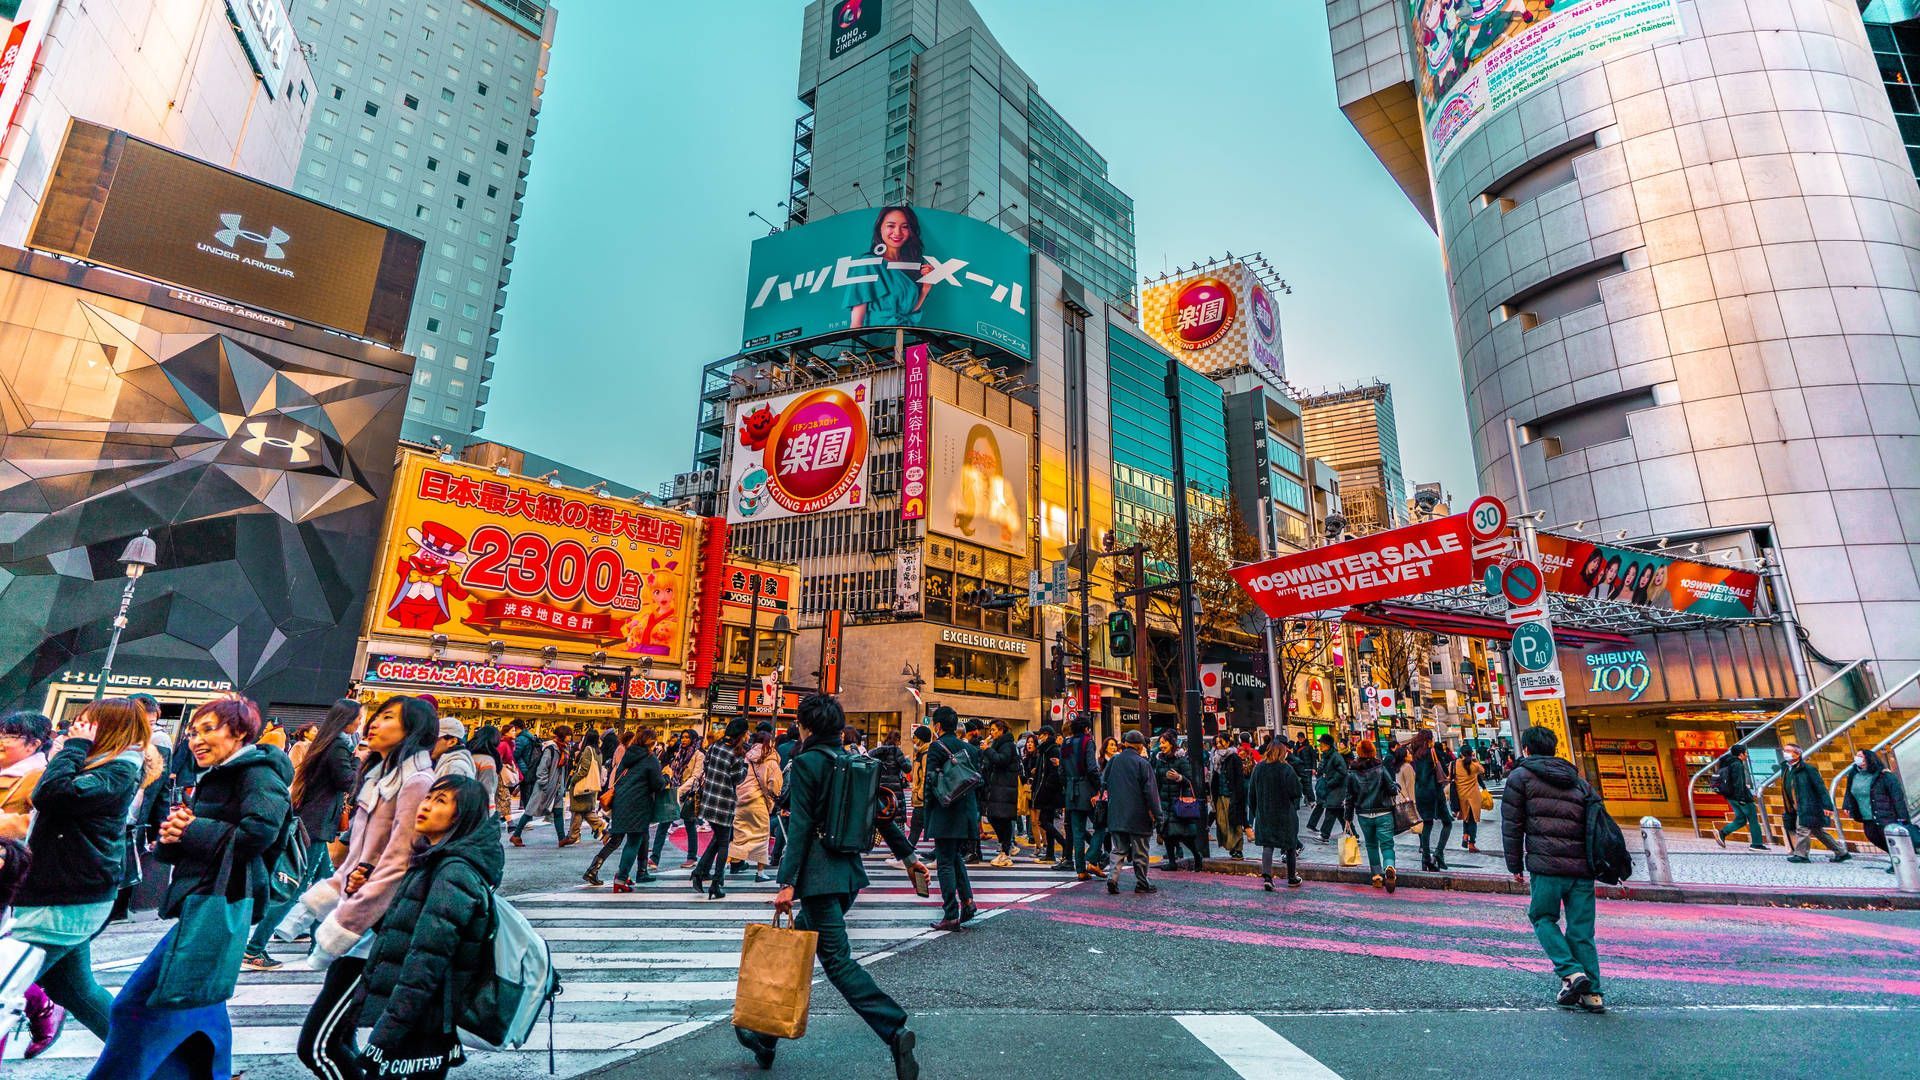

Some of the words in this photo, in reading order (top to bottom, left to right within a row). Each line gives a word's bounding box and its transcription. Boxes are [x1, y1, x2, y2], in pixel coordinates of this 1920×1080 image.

[836, 27, 859, 45] TOHO
[1569, 26, 1591, 39] Hop?
[1594, 14, 1621, 28] Stop?
[835, 31, 867, 53] CINEMAS
[1513, 35, 1543, 56] Release!
[1518, 53, 1548, 73] Release!
[1531, 60, 1559, 78] Brightest
[1560, 50, 1584, 63] Melody
[1589, 41, 1606, 51] Over
[1608, 35, 1622, 44] The
[1623, 29, 1640, 39] Next
[1518, 73, 1549, 93] Release!
[197, 242, 240, 260] UNDER
[242, 257, 294, 278] ARMOUR
[751, 256, 1026, 315] ハッピーメール
[194, 297, 234, 313] UNDER
[236, 308, 287, 327] ARMOUR
[1177, 297, 1225, 332] 楽園
[991, 329, 1026, 350] ハッピーメール
[907, 366, 923, 465] 品川美容外科
[778, 426, 852, 476] 楽園
[767, 475, 800, 511] EXCITING
[803, 461, 861, 513] AMUSEMENT
[418, 468, 684, 550] 日本最大級の超大型店
[1475, 506, 1499, 529] 30
[1511, 561, 1526, 569] 20-7
[730, 592, 777, 608] YOSHOYA
[1276, 586, 1298, 597] WITH
[613, 596, 640, 610] OVER
[504, 602, 594, 630] 渋谷地区合計
[1521, 624, 1540, 635] 7-20
[943, 629, 996, 649] EXCELSIOR
[998, 638, 1027, 654] CAFFÉ
[1520, 636, 1537, 666] P
[1534, 650, 1547, 665] 40
[1586, 651, 1646, 666] SHIBUYA
[156, 677, 232, 690] ARMOUR
[771, 671, 777, 681] 3
[1589, 663, 1650, 702] 109
[1367, 688, 1374, 696] 4
